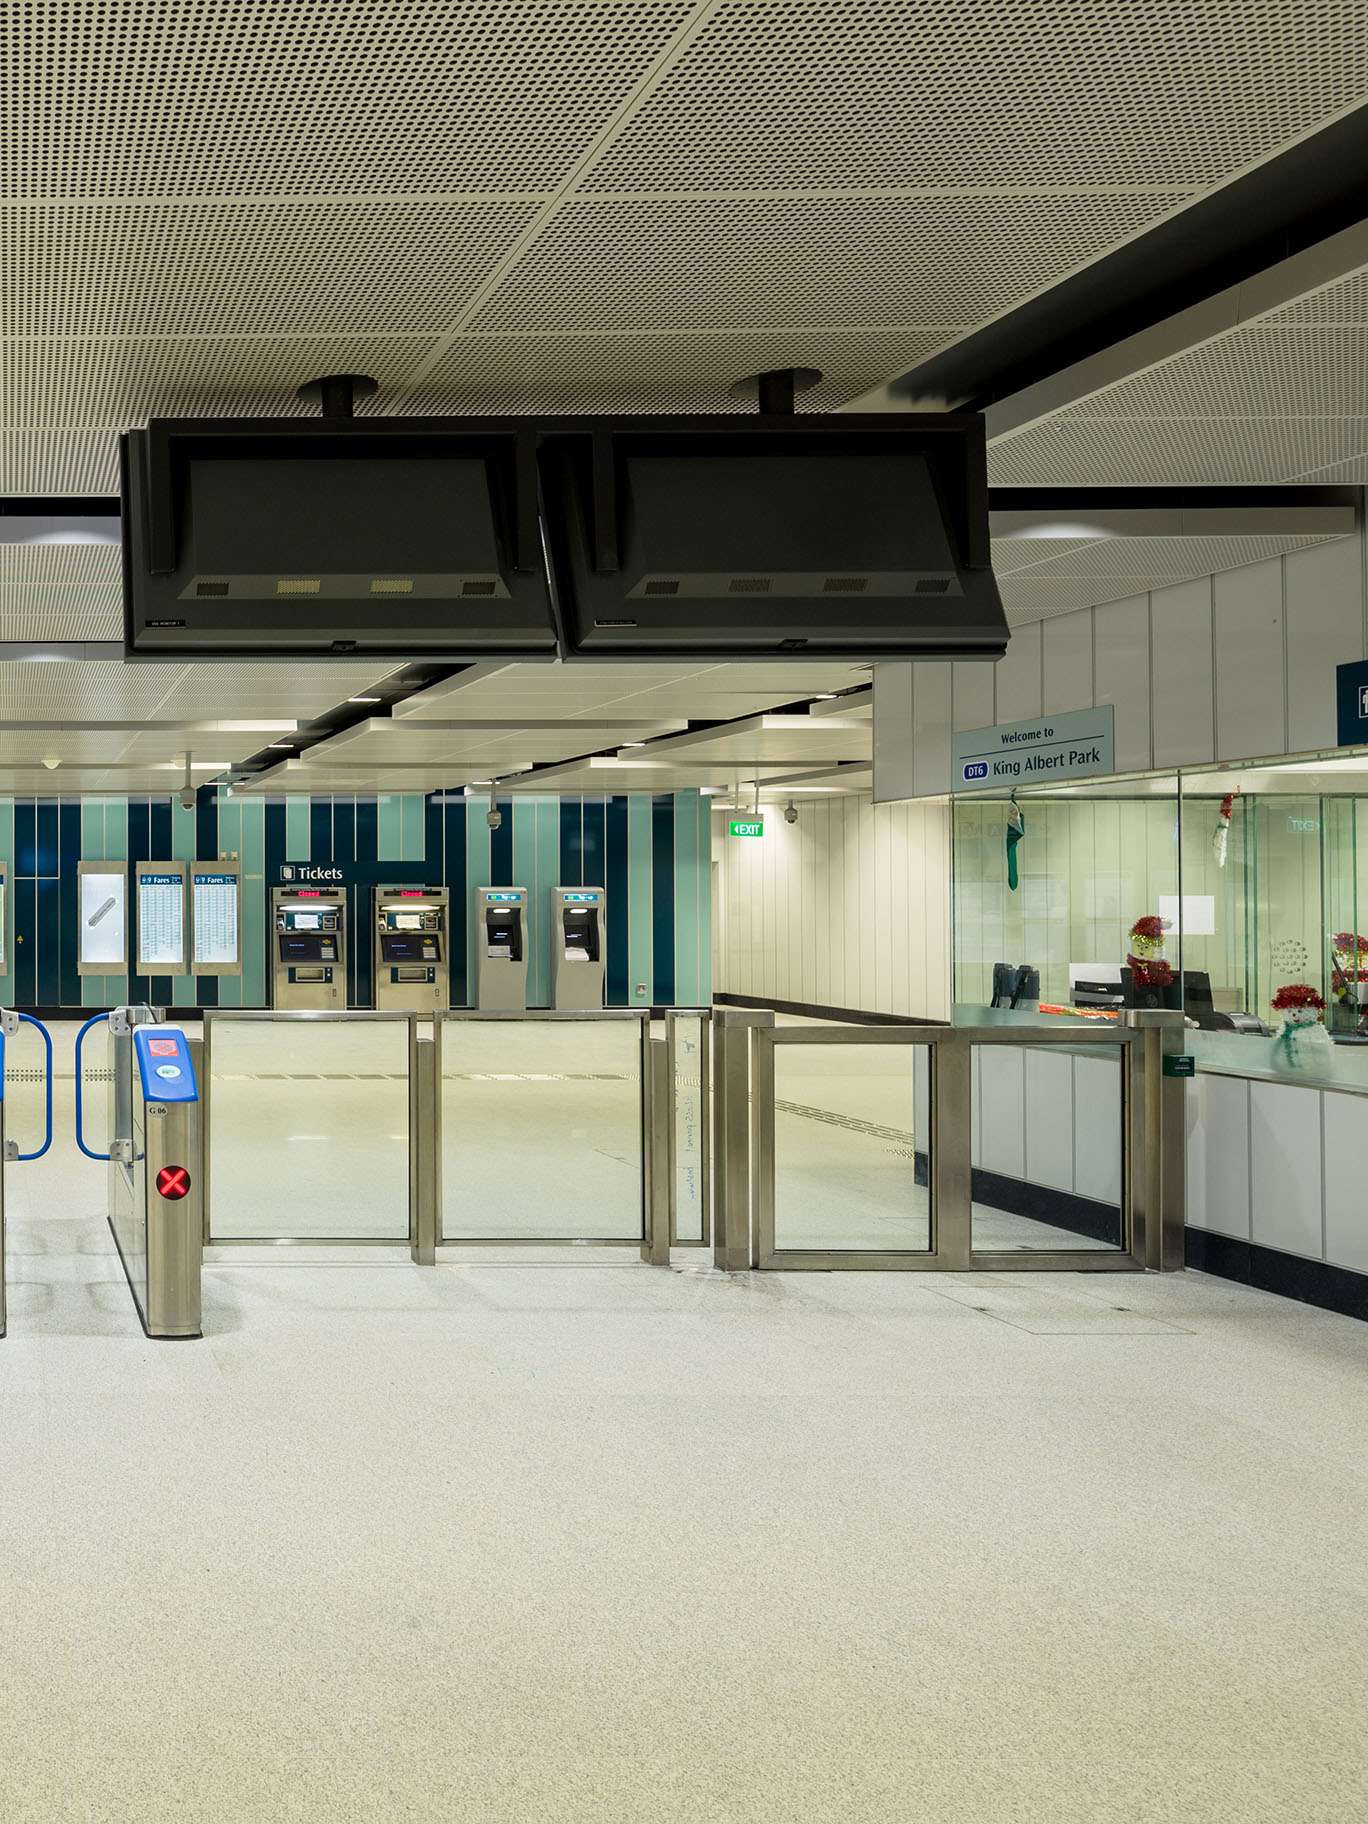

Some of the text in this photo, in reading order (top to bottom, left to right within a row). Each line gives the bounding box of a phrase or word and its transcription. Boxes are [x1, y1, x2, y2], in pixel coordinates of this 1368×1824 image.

[1001, 727, 1054, 744] Welcome to
[968, 747, 1100, 777] DT6 King Albert Park
[739, 824, 760, 835] EXIT
[298, 867, 343, 880] Tickets
